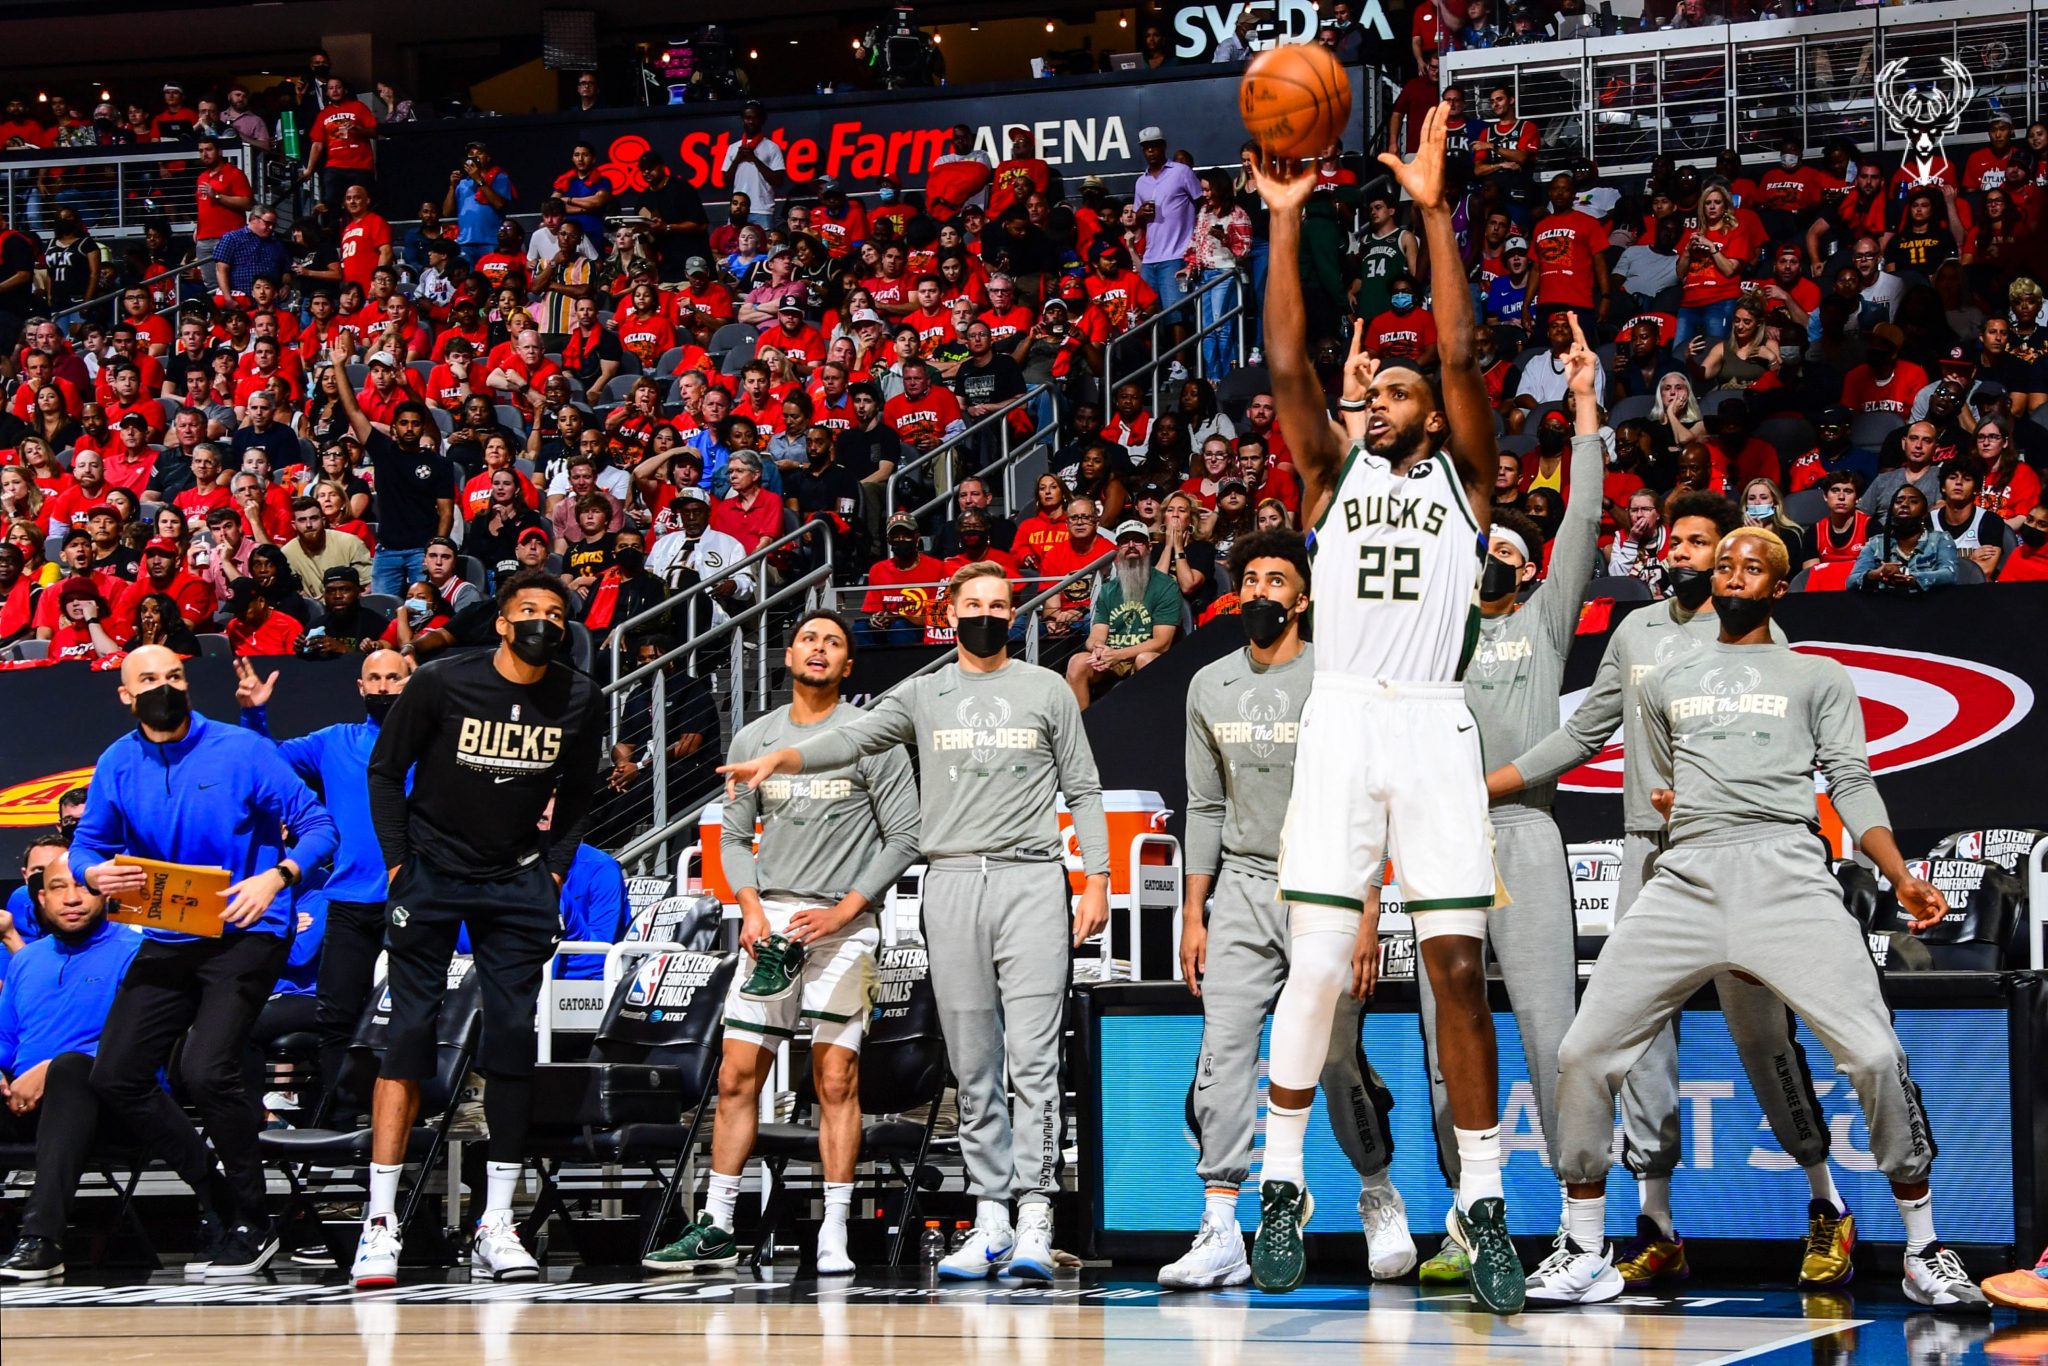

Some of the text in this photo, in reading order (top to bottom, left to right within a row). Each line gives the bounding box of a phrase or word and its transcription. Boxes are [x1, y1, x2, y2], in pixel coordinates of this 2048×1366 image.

[1174, 0, 1394, 58] SVEDA
[680, 127, 818, 189] Stte
[826, 121, 956, 179] Farm
[1766, 182, 1804, 192] BELIEVE
[1983, 175, 2007, 184] ATLAN
[1536, 229, 1576, 243] BELIEVE
[342, 240, 358, 259] 20
[1909, 247, 1927, 265] 11
[1367, 258, 1387, 278] 34
[623, 332, 657, 345] BELIEVE
[1379, 331, 1418, 345] BELIEVE
[1863, 399, 1905, 413] ELIEVE
[896, 410, 938, 429] BELIEVE
[470, 489, 493, 502] BELI
[1343, 496, 1448, 536] BUCKS
[571, 550, 604, 567] HAWKS
[1357, 545, 1421, 601] 22
[1109, 601, 1152, 626] MILWAUKEE
[1670, 696, 1716, 723] FEAR
[1739, 693, 1788, 720] DEER
[457, 716, 563, 761] BUCKS
[933, 729, 974, 751] FEAR
[996, 728, 1038, 750] DEER
[1213, 722, 1253, 744] FEAR
[810, 779, 852, 799] DEER
[1985, 828, 2036, 845] EASTERN
[1984, 842, 2032, 856] CONFERENCE
[1932, 860, 1987, 879] EASTERN
[1144, 879, 1175, 892] GATORADE
[1931, 876, 1983, 891] CONFERENCE
[147, 872, 169, 921] SPALDING
[666, 952, 722, 975] EASTERN
[661, 971, 712, 988] CONFERENCE
[653, 987, 695, 1008] FINALS
[876, 982, 914, 1004] INALS
[559, 997, 604, 1012] GATORAD
[882, 1008, 910, 1018] AT&T
[661, 1011, 687, 1022] AT&T
[1773, 1053, 1813, 1141] MILWAUKEE BUCKS
[1350, 1085, 1376, 1154] MILWAUKEE BUCKS
[1040, 1100, 1054, 1188] MILWAUKEE BUCKS
[1910, 1121, 1926, 1157] BUCKS
